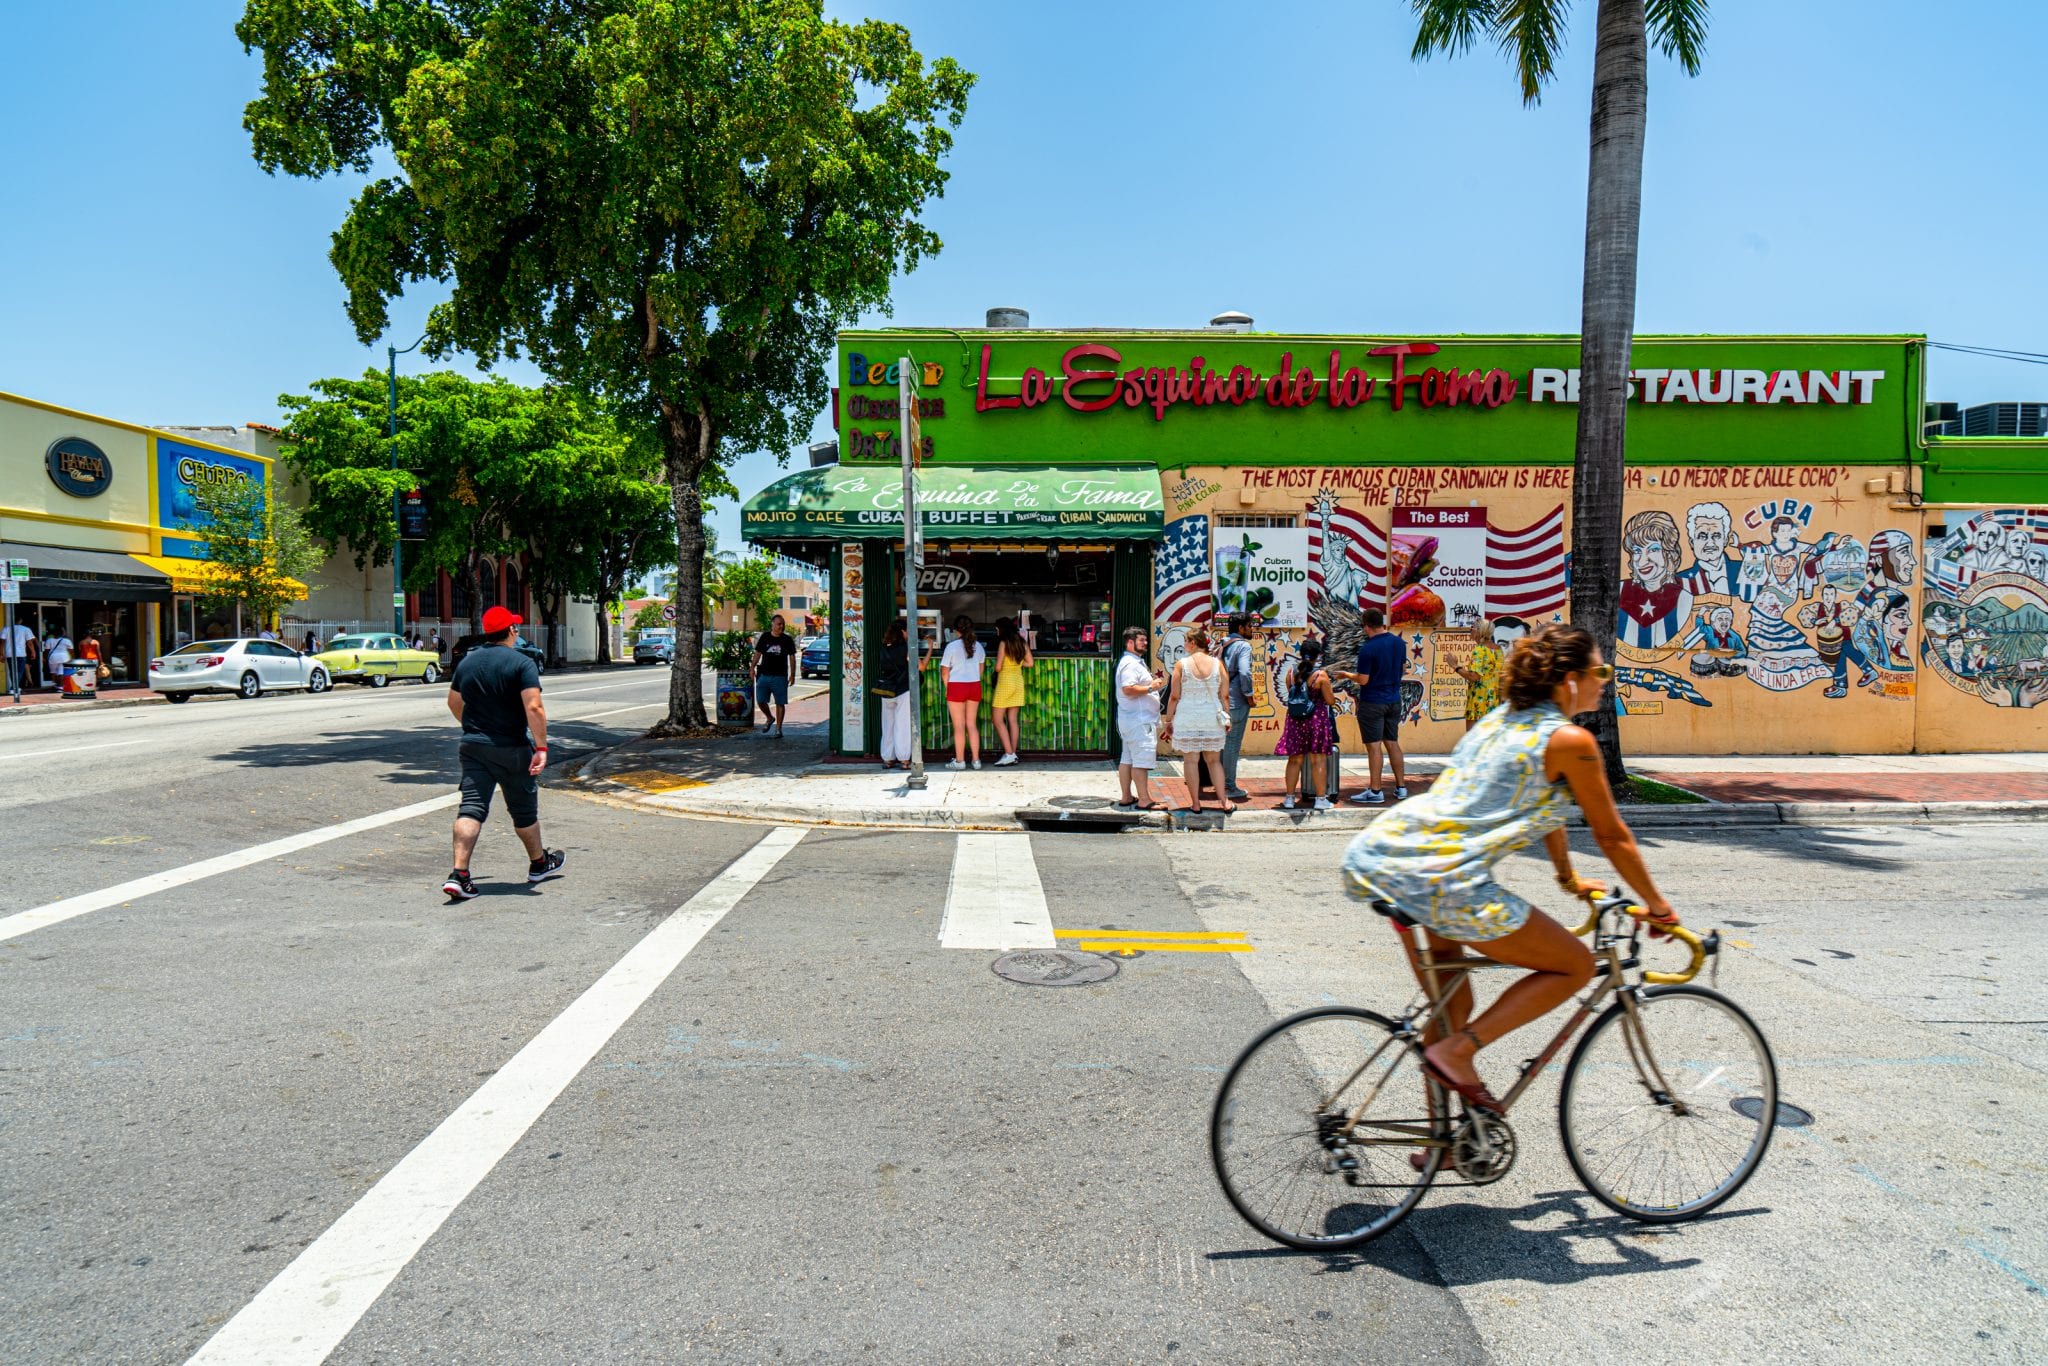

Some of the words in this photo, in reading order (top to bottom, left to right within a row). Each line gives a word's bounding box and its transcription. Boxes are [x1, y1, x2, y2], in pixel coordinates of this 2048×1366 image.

[848, 352, 900, 386] Bee
[976, 343, 1054, 412] La
[1061, 343, 1262, 421] Esquina
[1265, 351, 1322, 408] de
[1328, 349, 1376, 409] la
[1366, 342, 1518, 411] Fama
[1528, 368, 1885, 405] RTAURANT
[832, 477, 872, 494] La
[1005, 480, 1040, 493] De
[1171, 476, 1198, 493] CUBAN
[1242, 469, 1274, 488] THE
[1276, 468, 1317, 488] MOST
[1320, 468, 1384, 488] FAMOUS
[1388, 467, 1436, 489] CUBAN
[1439, 468, 1509, 490] SANDWICH
[1514, 469, 1529, 488] IS
[1533, 468, 1571, 489] HERE
[1661, 469, 1680, 488] LO
[1684, 468, 1727, 488] MEJOR
[1731, 468, 1751, 488] DE
[1753, 467, 1796, 488] CALLE
[1013, 493, 1040, 507] la
[1054, 480, 1162, 509] Fama
[1173, 479, 1207, 504] MOJITO
[1195, 482, 1223, 501] COLADA
[747, 512, 797, 523] MOJITO
[805, 506, 846, 523] CAFÉ
[858, 510, 922, 524] CUBA
[929, 511, 1014, 524] BUFFET
[1060, 511, 1092, 524] CUBAN
[1097, 511, 1147, 525] SANDWICH
[1409, 511, 1435, 523] The
[1439, 511, 1470, 523] Best
[1744, 498, 1813, 530] CUBA
[1264, 557, 1292, 565] Cuban
[916, 570, 963, 591] PEN
[1250, 566, 1306, 586] Mojito
[1440, 566, 1483, 577] Cuban
[1427, 577, 1483, 588] Sandwich
[1767, 672, 1798, 689] LINDA
[1800, 665, 1828, 683] ERES
[1251, 720, 1263, 731] DE
[1266, 720, 1280, 731] LA
